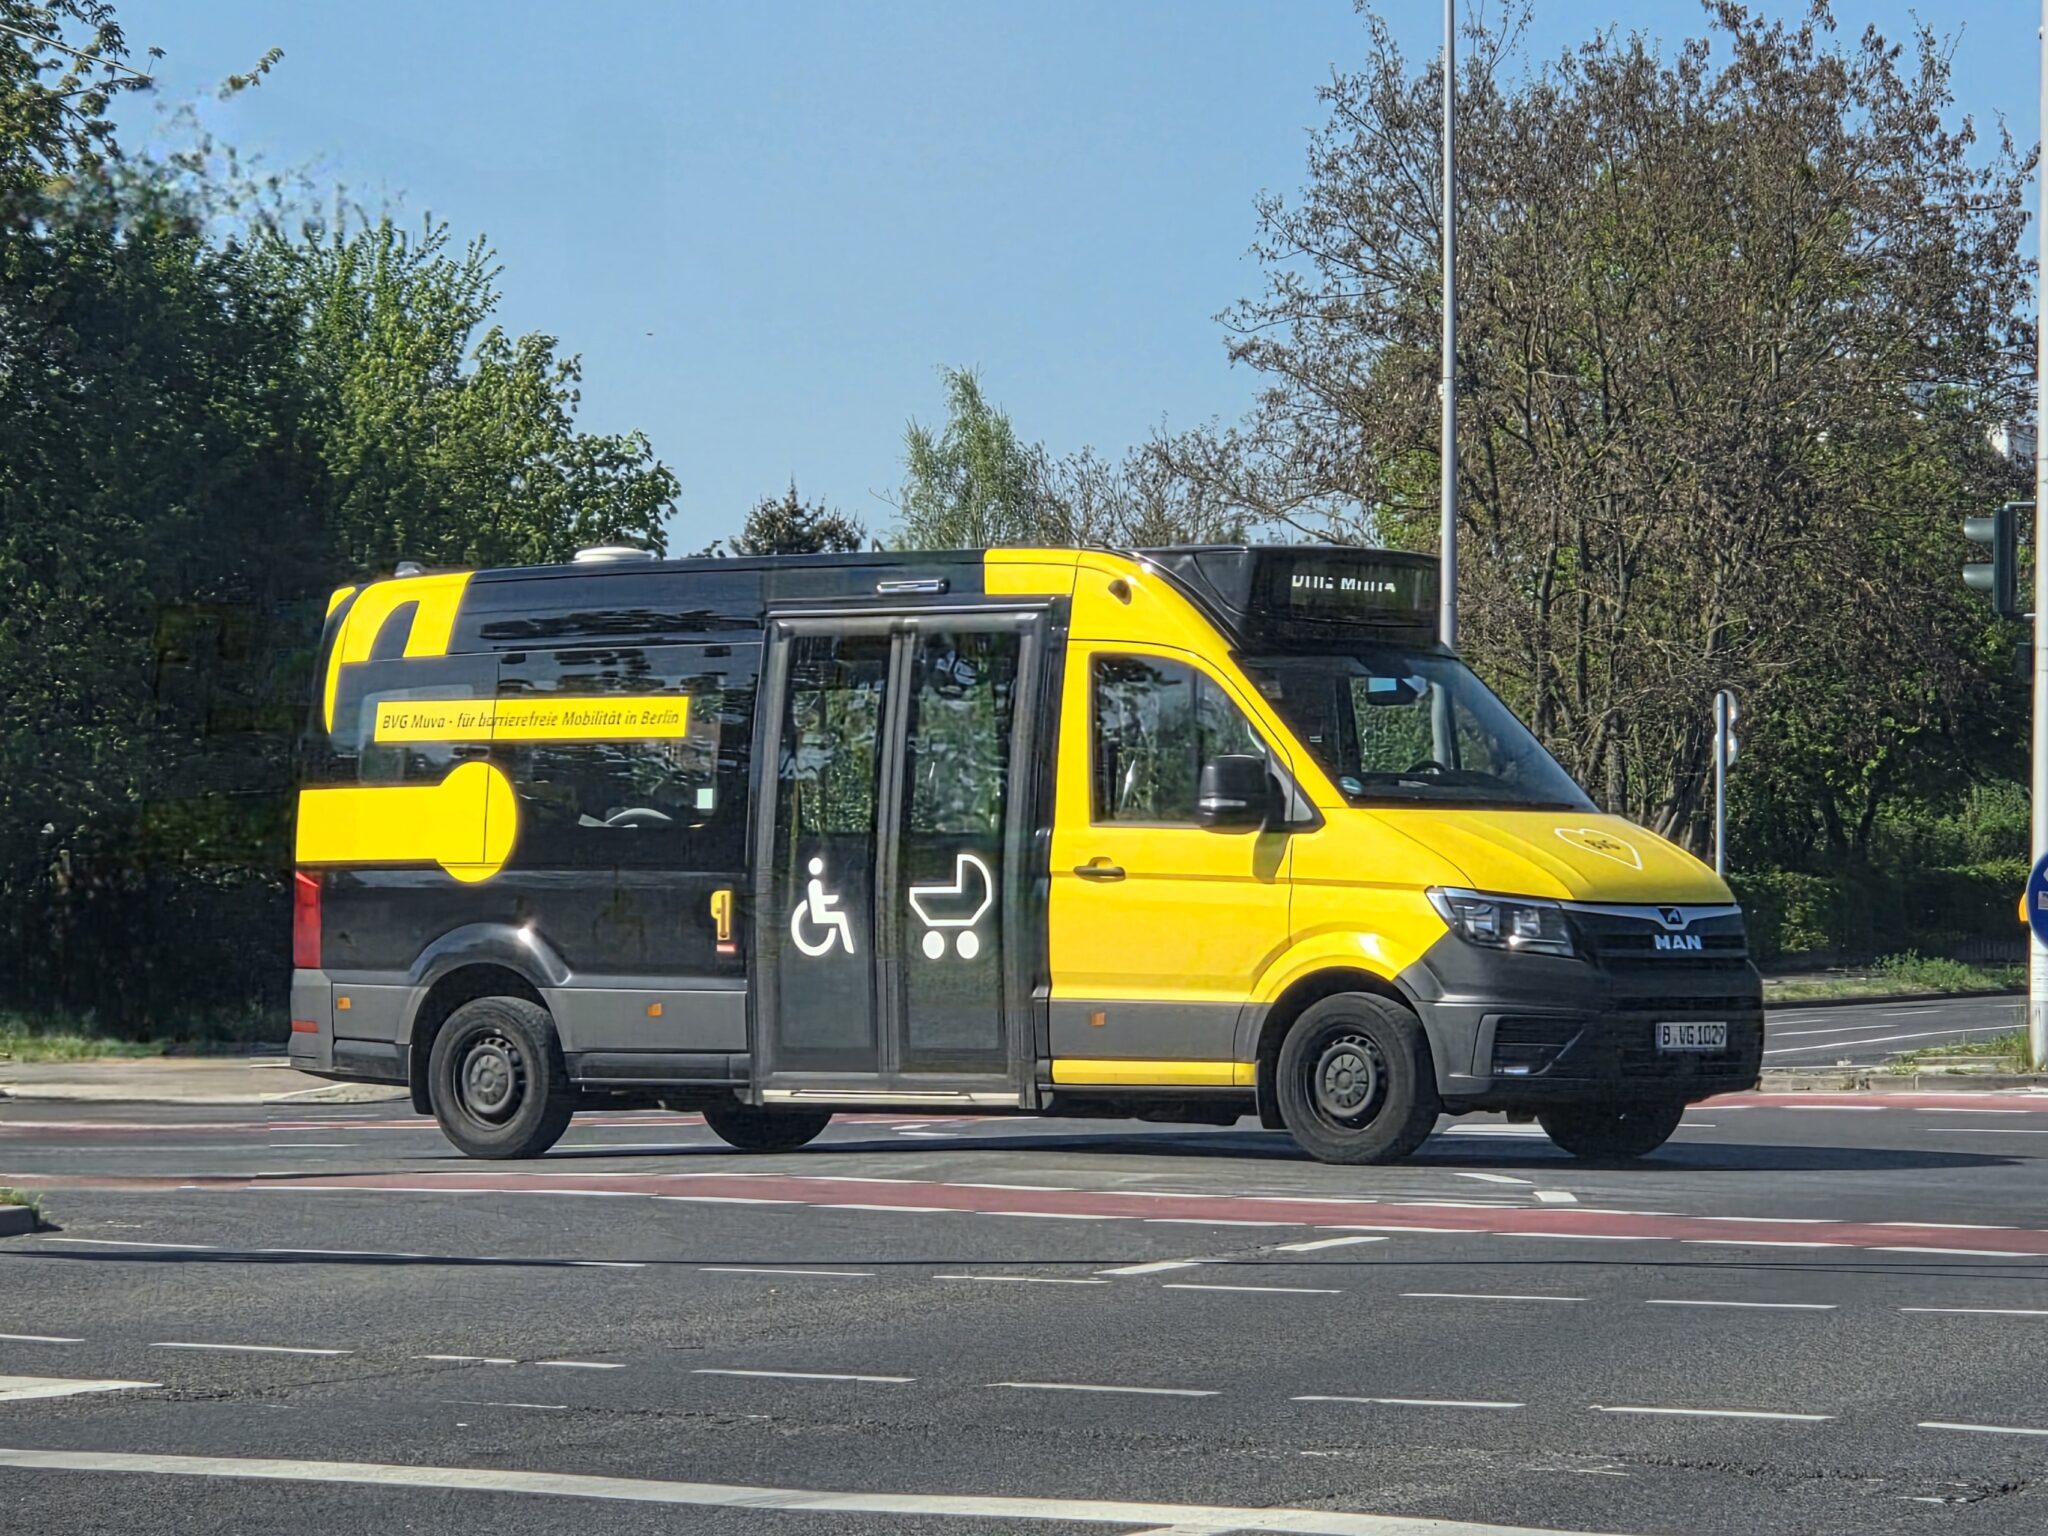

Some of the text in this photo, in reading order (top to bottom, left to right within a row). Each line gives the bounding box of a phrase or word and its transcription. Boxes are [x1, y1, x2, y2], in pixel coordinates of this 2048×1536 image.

[382, 714, 408, 729] BVG
[410, 714, 446, 729] Muva
[456, 712, 476, 728] für
[478, 711, 558, 728] barrierefreie
[562, 709, 622, 726] Mobilität
[625, 710, 637, 725] in
[640, 709, 679, 725] Berlin
[1653, 934, 1703, 950] MAN
